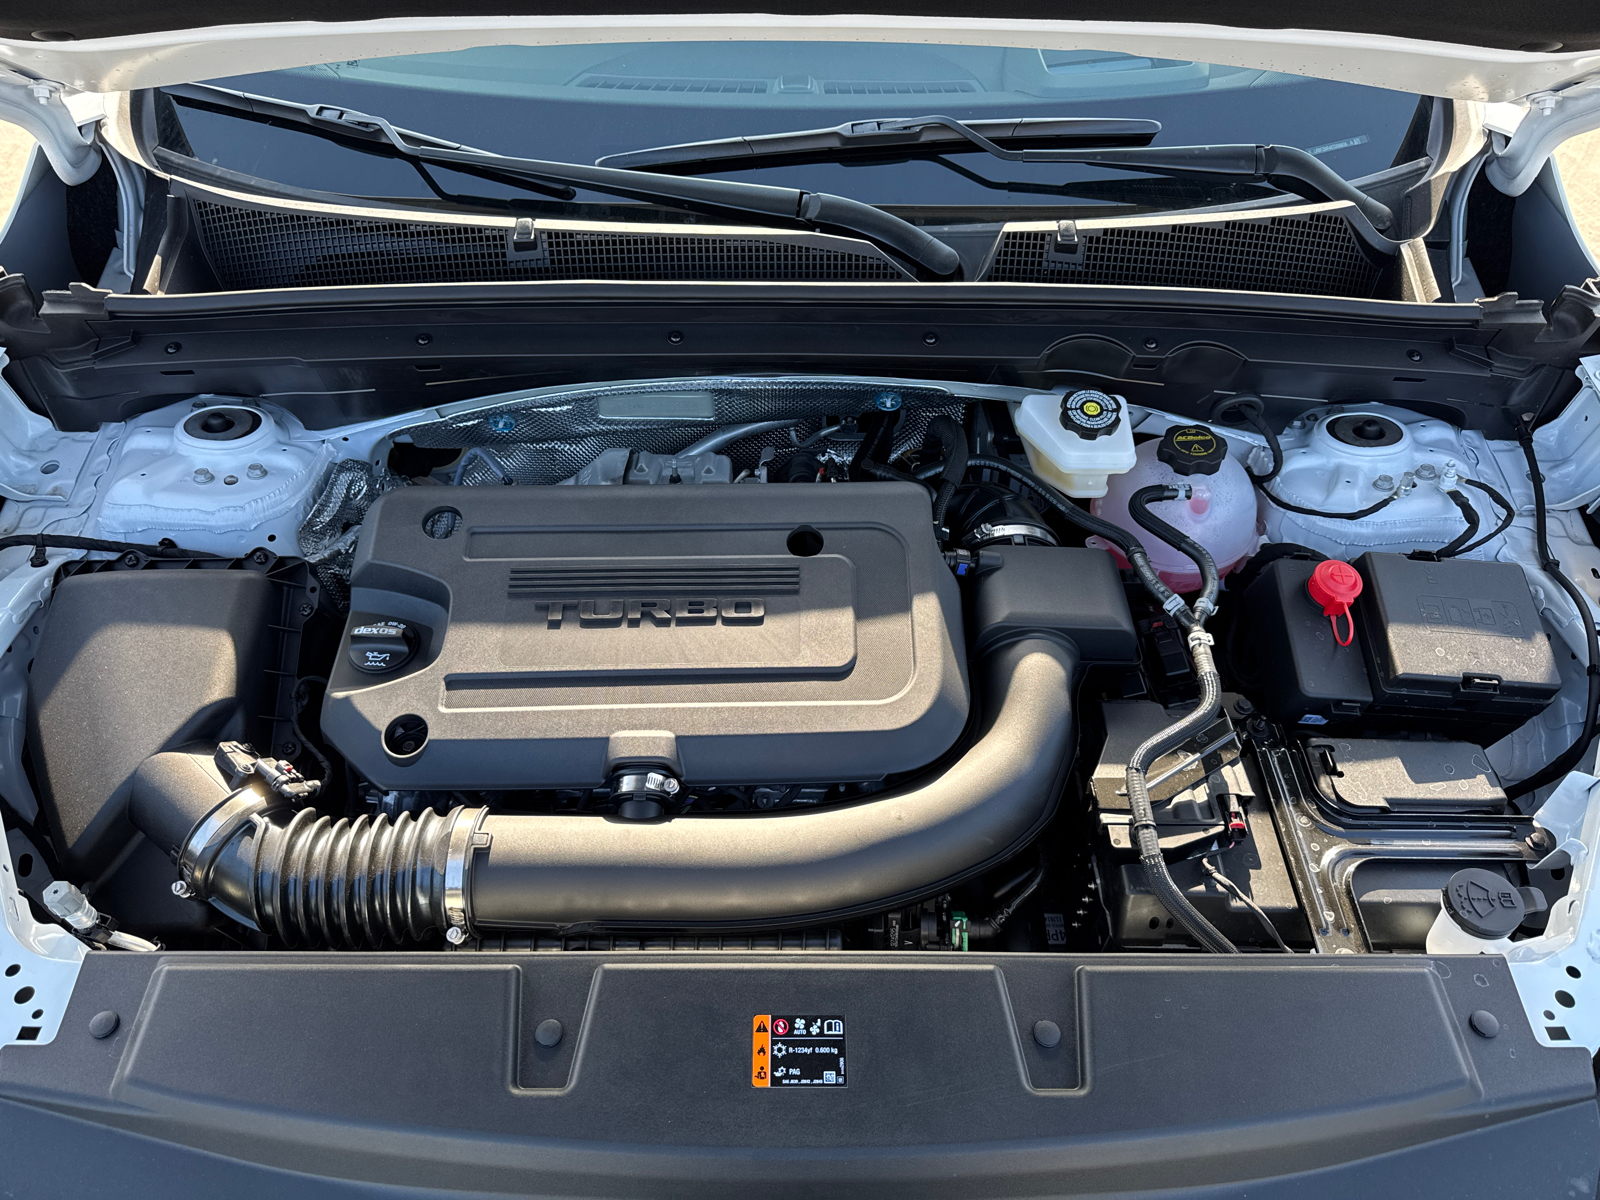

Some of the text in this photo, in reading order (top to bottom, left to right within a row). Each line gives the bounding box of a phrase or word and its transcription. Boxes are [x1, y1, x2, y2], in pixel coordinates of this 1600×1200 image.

[534, 598, 765, 630] TURBO
[353, 625, 398, 635] dexos
[788, 1046, 813, 1055] R-1234yf
[831, 1046, 839, 1055] kg
